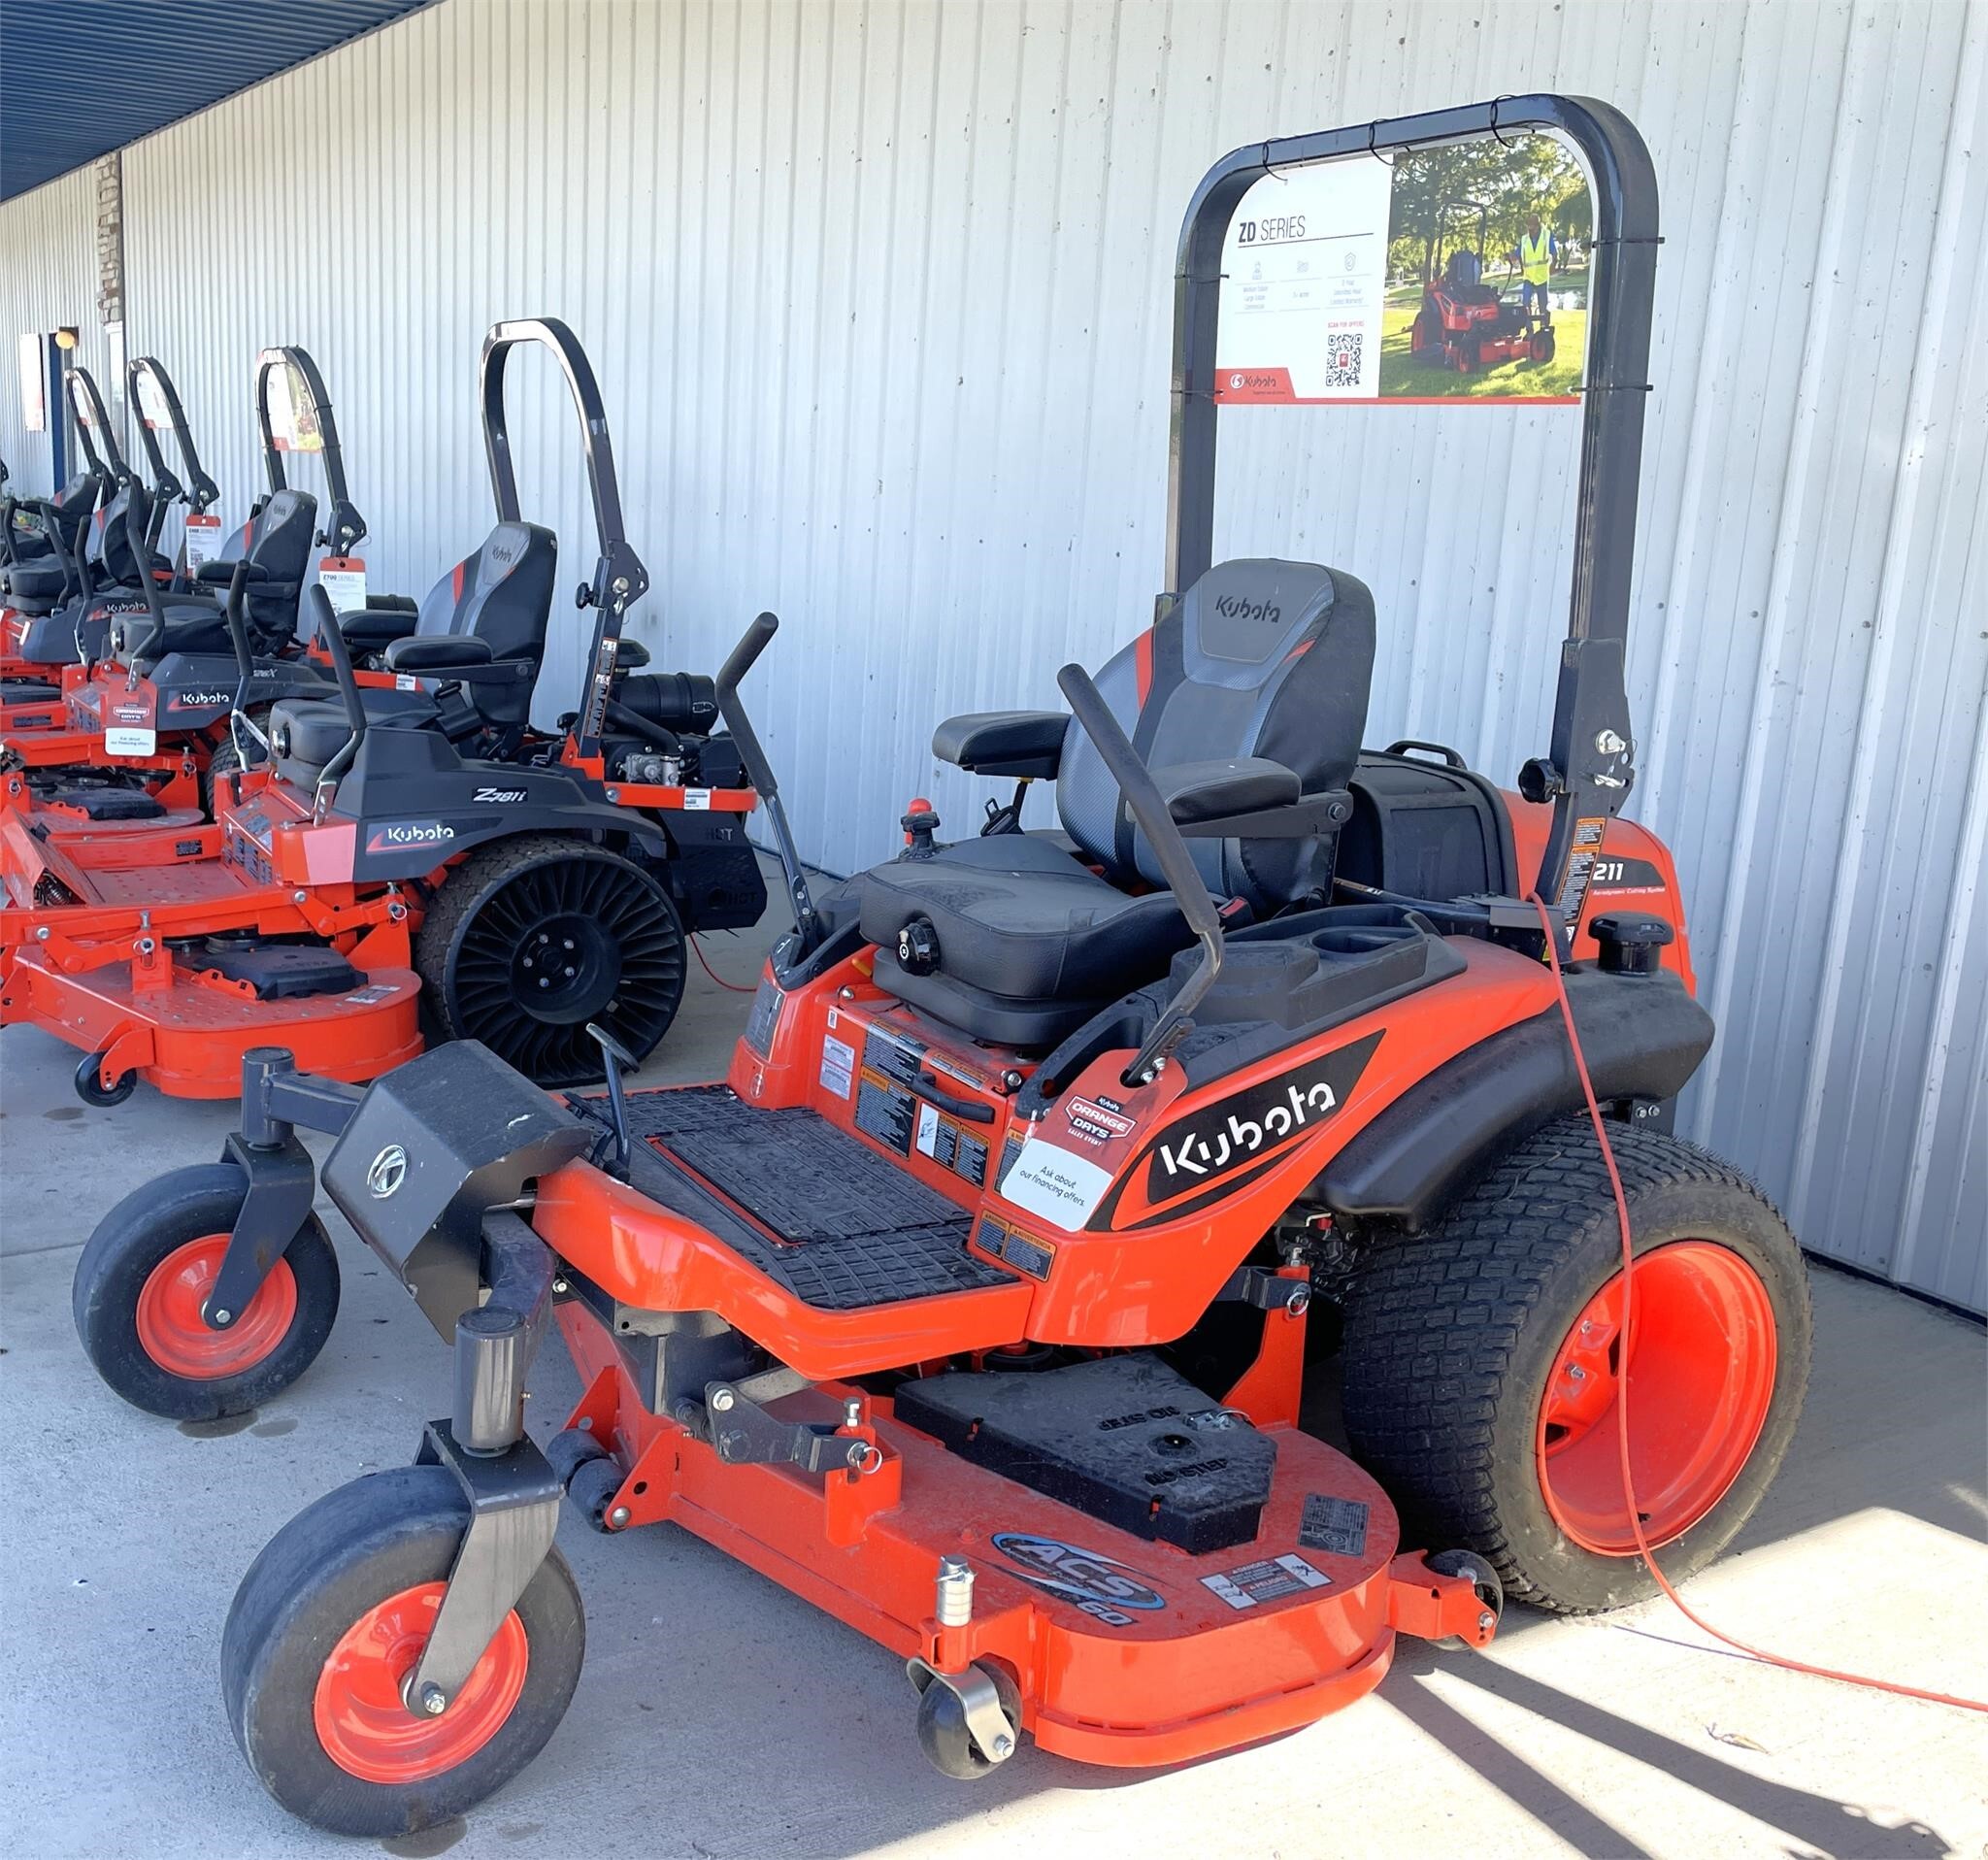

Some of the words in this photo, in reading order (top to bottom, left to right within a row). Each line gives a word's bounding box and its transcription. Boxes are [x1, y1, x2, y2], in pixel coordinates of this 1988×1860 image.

[1238, 221, 1256, 244] ZD
[1260, 215, 1306, 242] SERIES
[1244, 375, 1277, 387] Kubota
[106, 600, 147, 614] Kubota
[1215, 595, 1281, 623] Kubota
[182, 691, 230, 704] Kubota
[387, 823, 455, 844] Kubota
[1592, 862, 1624, 881] 211
[1071, 1101, 1129, 1133] ORANGE
[1073, 1116, 1110, 1140] DAYS
[1159, 1081, 1337, 1176] Kubota
[1067, 1127, 1084, 1140] SALES
[1083, 1134, 1103, 1147] EVENT
[1019, 1169, 1032, 1180] our
[1031, 1174, 1064, 1198] financing
[1063, 1190, 1085, 1208] offers.
[1040, 1165, 1055, 1179] Ask
[1054, 1173, 1077, 1190] about
[1012, 1544, 1149, 1598] ACS
[1076, 1601, 1136, 1627] 60
